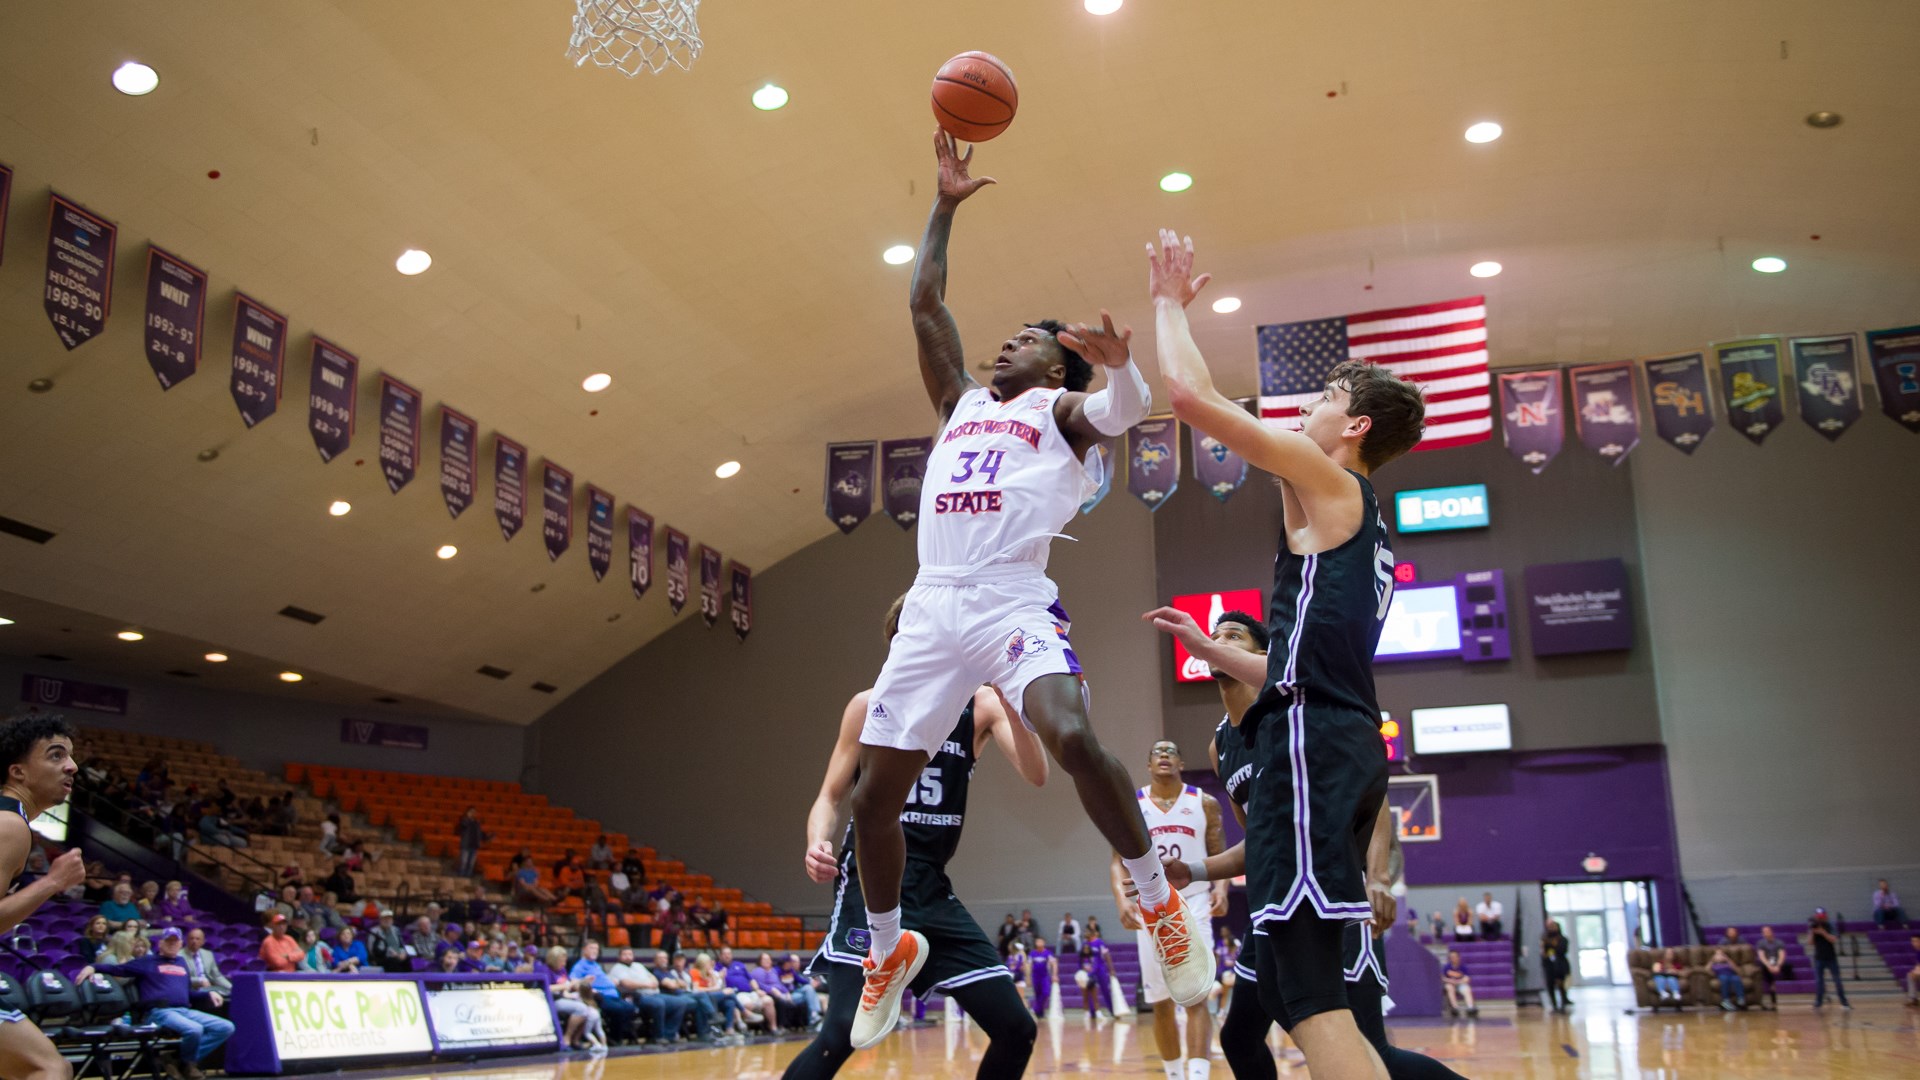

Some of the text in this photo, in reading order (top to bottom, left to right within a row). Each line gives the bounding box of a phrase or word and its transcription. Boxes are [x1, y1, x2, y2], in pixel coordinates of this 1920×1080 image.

[963, 72, 987, 87] ROCK
[56, 251, 100, 278] CHAMPION
[67, 267, 88, 284] PAM
[49, 270, 101, 303] HUDSON
[46, 285, 102, 321] 1989-90
[53, 312, 75, 331] 15.1
[148, 313, 195, 345] 1992-93
[152, 339, 186, 363] 24-8
[233, 355, 277, 387] 1994-95
[236, 381, 267, 403] 25-7
[943, 418, 1042, 453] NORTHWESTERN
[950, 449, 1008, 485] 34
[935, 490, 1003, 515] STATE
[1423, 495, 1484, 520] BOM
[631, 561, 648, 585] 10
[667, 579, 685, 602] 25
[731, 609, 750, 631] 45
[899, 811, 962, 826] KANSAS
[1157, 843, 1182, 861] 20
[269, 988, 347, 1031] FROG
[283, 1029, 387, 1053] Apartments
